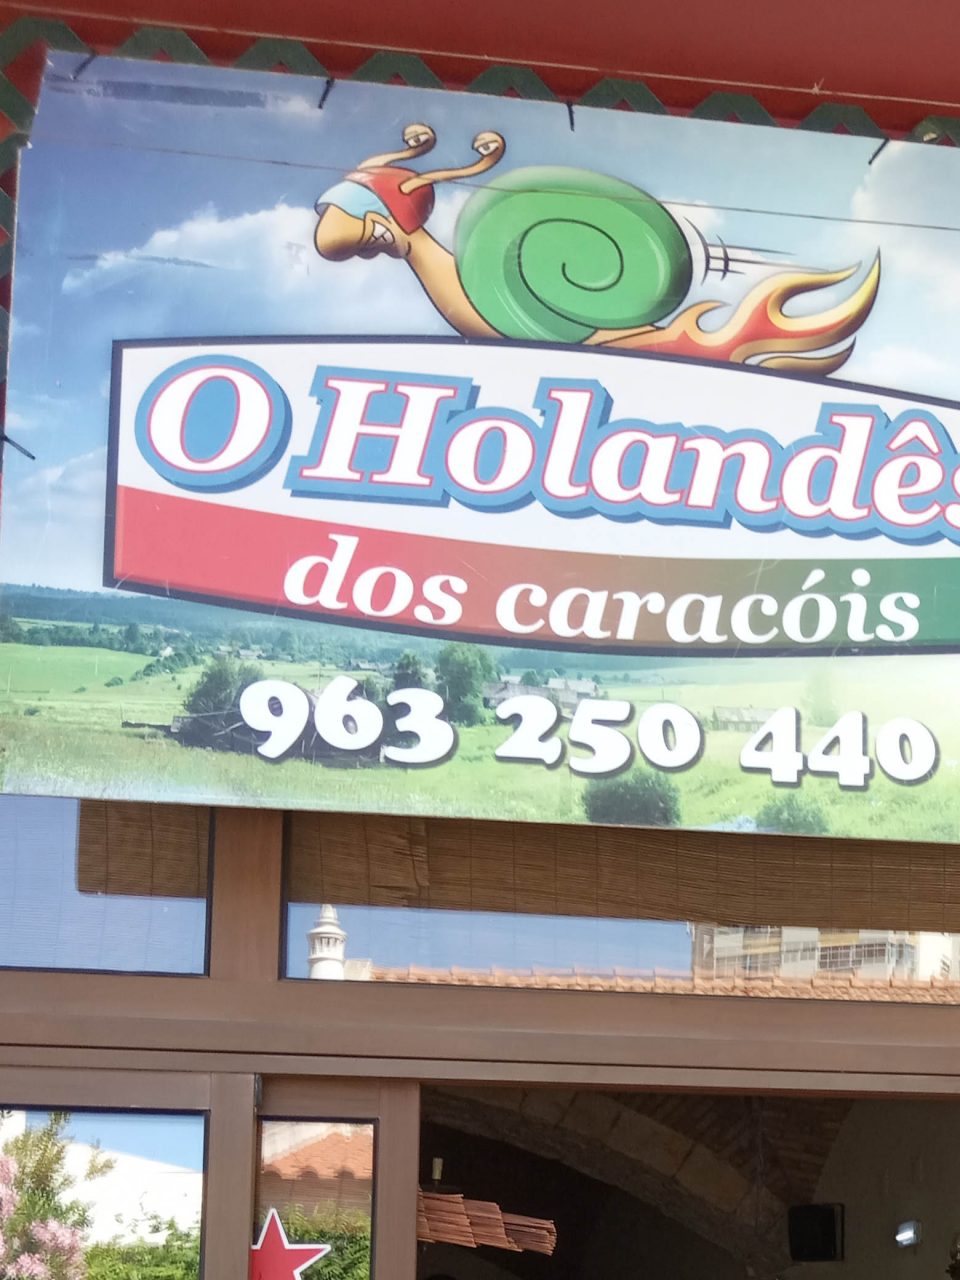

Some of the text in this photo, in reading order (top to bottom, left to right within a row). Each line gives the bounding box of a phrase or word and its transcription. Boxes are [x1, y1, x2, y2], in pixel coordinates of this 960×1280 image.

[142, 360, 280, 484] O
[284, 533, 922, 646] dos caracóis
[239, 676, 939, 791] 963 250 440
